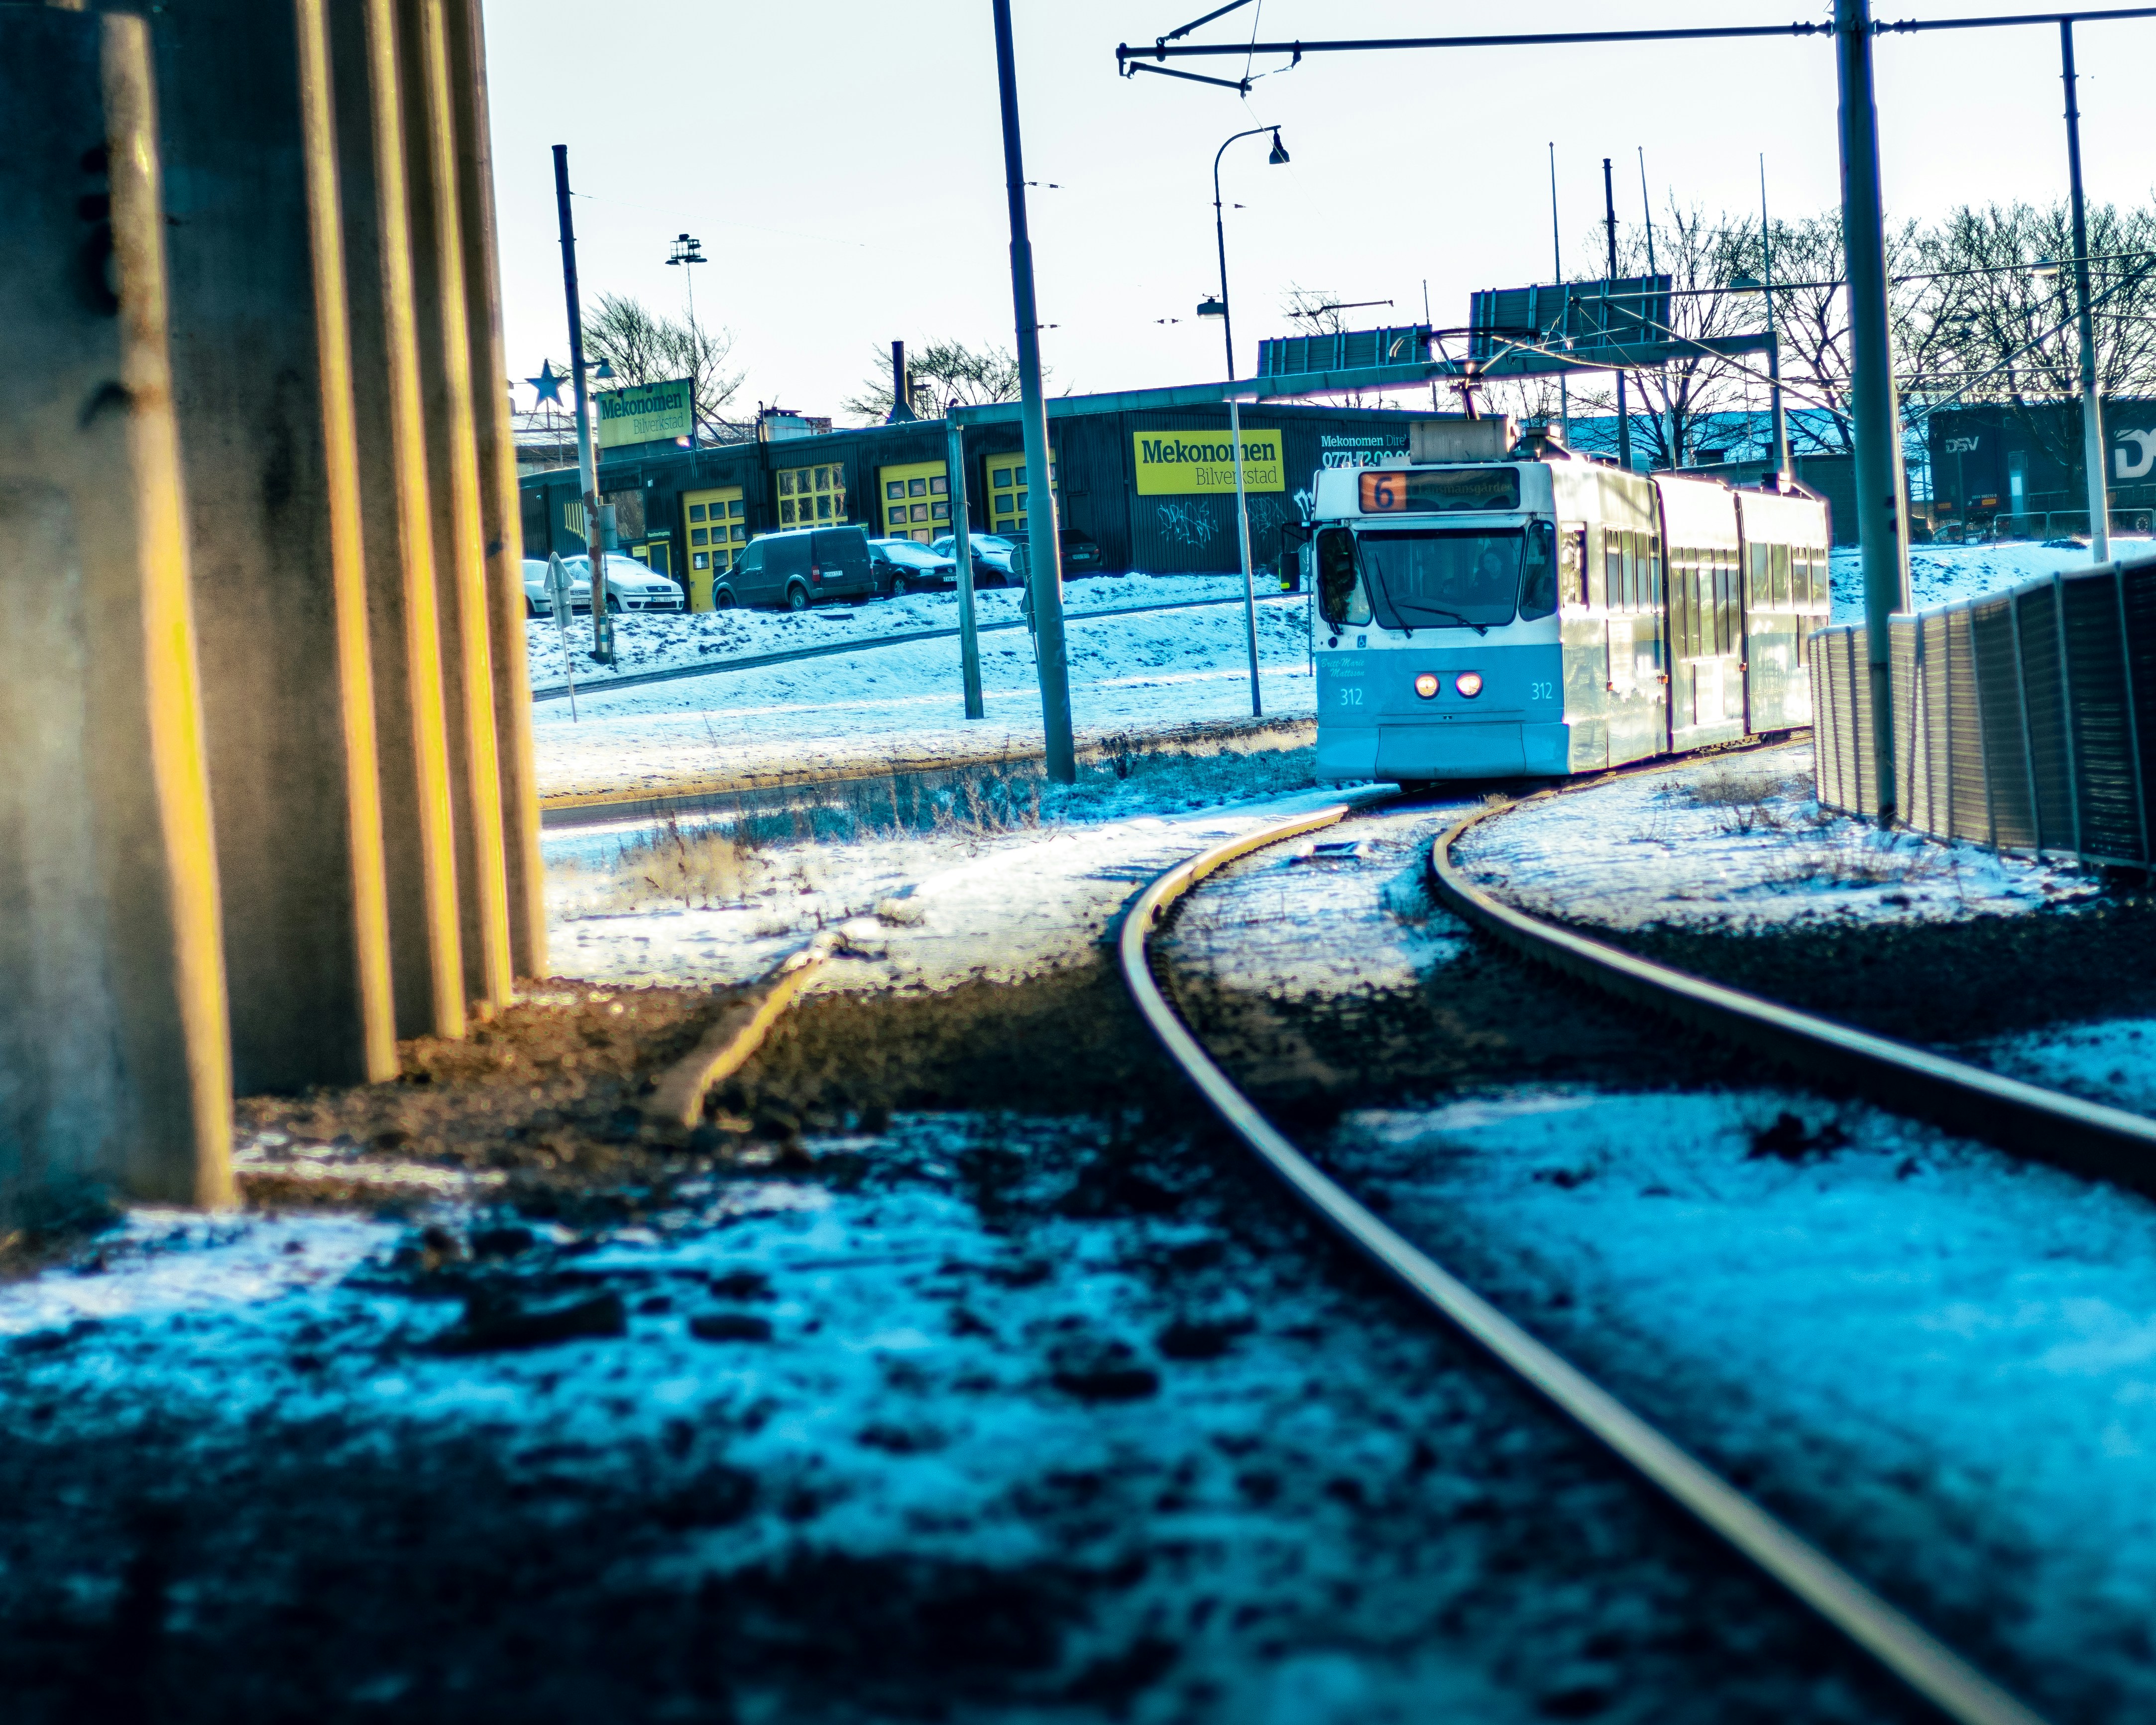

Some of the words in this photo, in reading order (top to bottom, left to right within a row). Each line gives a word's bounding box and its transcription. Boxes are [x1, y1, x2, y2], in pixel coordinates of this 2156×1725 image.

[601, 392, 683, 420] Mekonomen
[634, 413, 684, 435] Bilverkstad
[1141, 440, 1276, 464] Mekonomen
[1321, 436, 1384, 447] Mekonomen
[1945, 436, 1979, 454] DSV
[2114, 428, 2156, 478] D
[1374, 476, 1394, 509] 6
[1340, 689, 1363, 705] 312
[1532, 682, 1553, 700] 312
